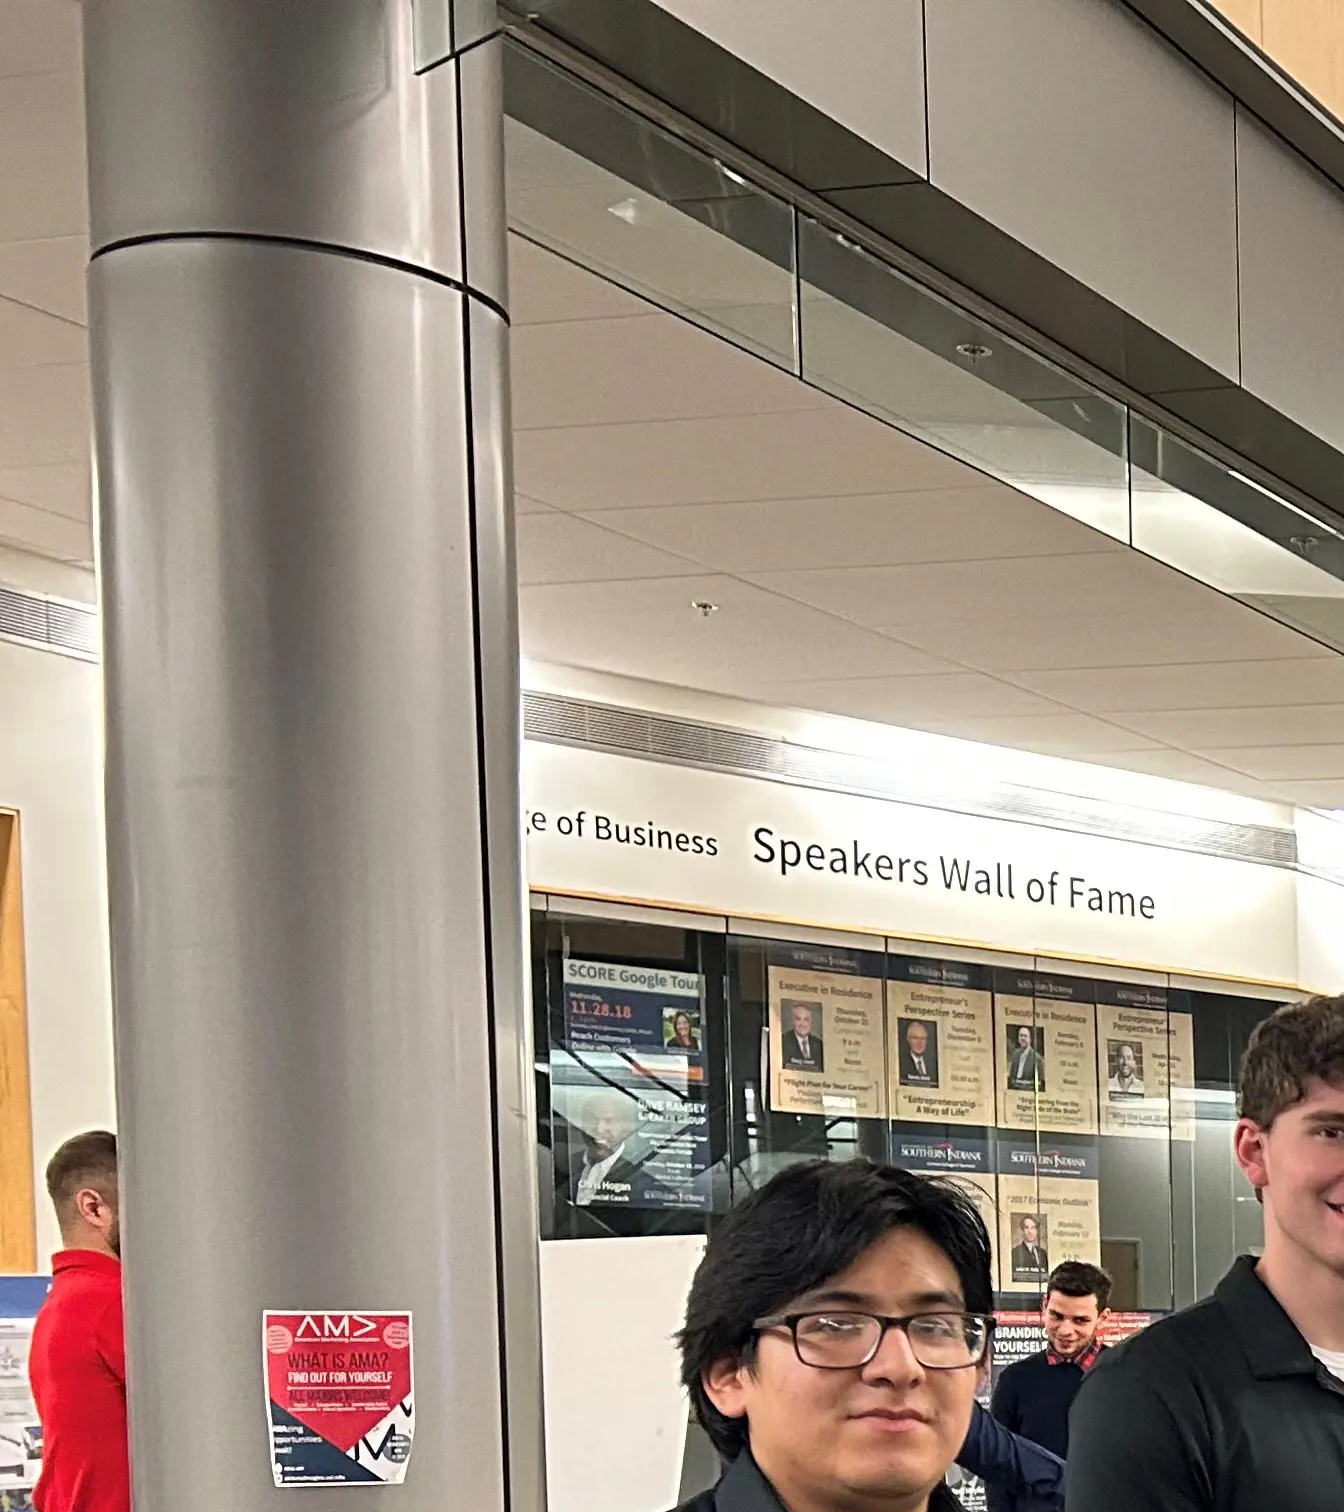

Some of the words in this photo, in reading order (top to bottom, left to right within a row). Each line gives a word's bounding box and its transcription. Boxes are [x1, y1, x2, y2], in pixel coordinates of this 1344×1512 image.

[526, 810, 547, 836] e
[557, 811, 586, 837] of
[595, 815, 718, 856] Business
[753, 826, 929, 886] Speakers
[940, 855, 1015, 899] Wall
[1026, 871, 1059, 905] of
[1070, 876, 1156, 920] Fame
[569, 963, 616, 982] SCORE
[619, 970, 667, 989] Google
[602, 1181, 631, 1193] Hogan
[288, 1352, 329, 1369] WHAT
[332, 1352, 345, 1369] IS
[349, 1352, 389, 1369] AMA?
[288, 1371, 308, 1383] FIND
[309, 1372, 328, 1383] OUT
[329, 1372, 347, 1383] FOR
[349, 1371, 393, 1384] YOURSELF
